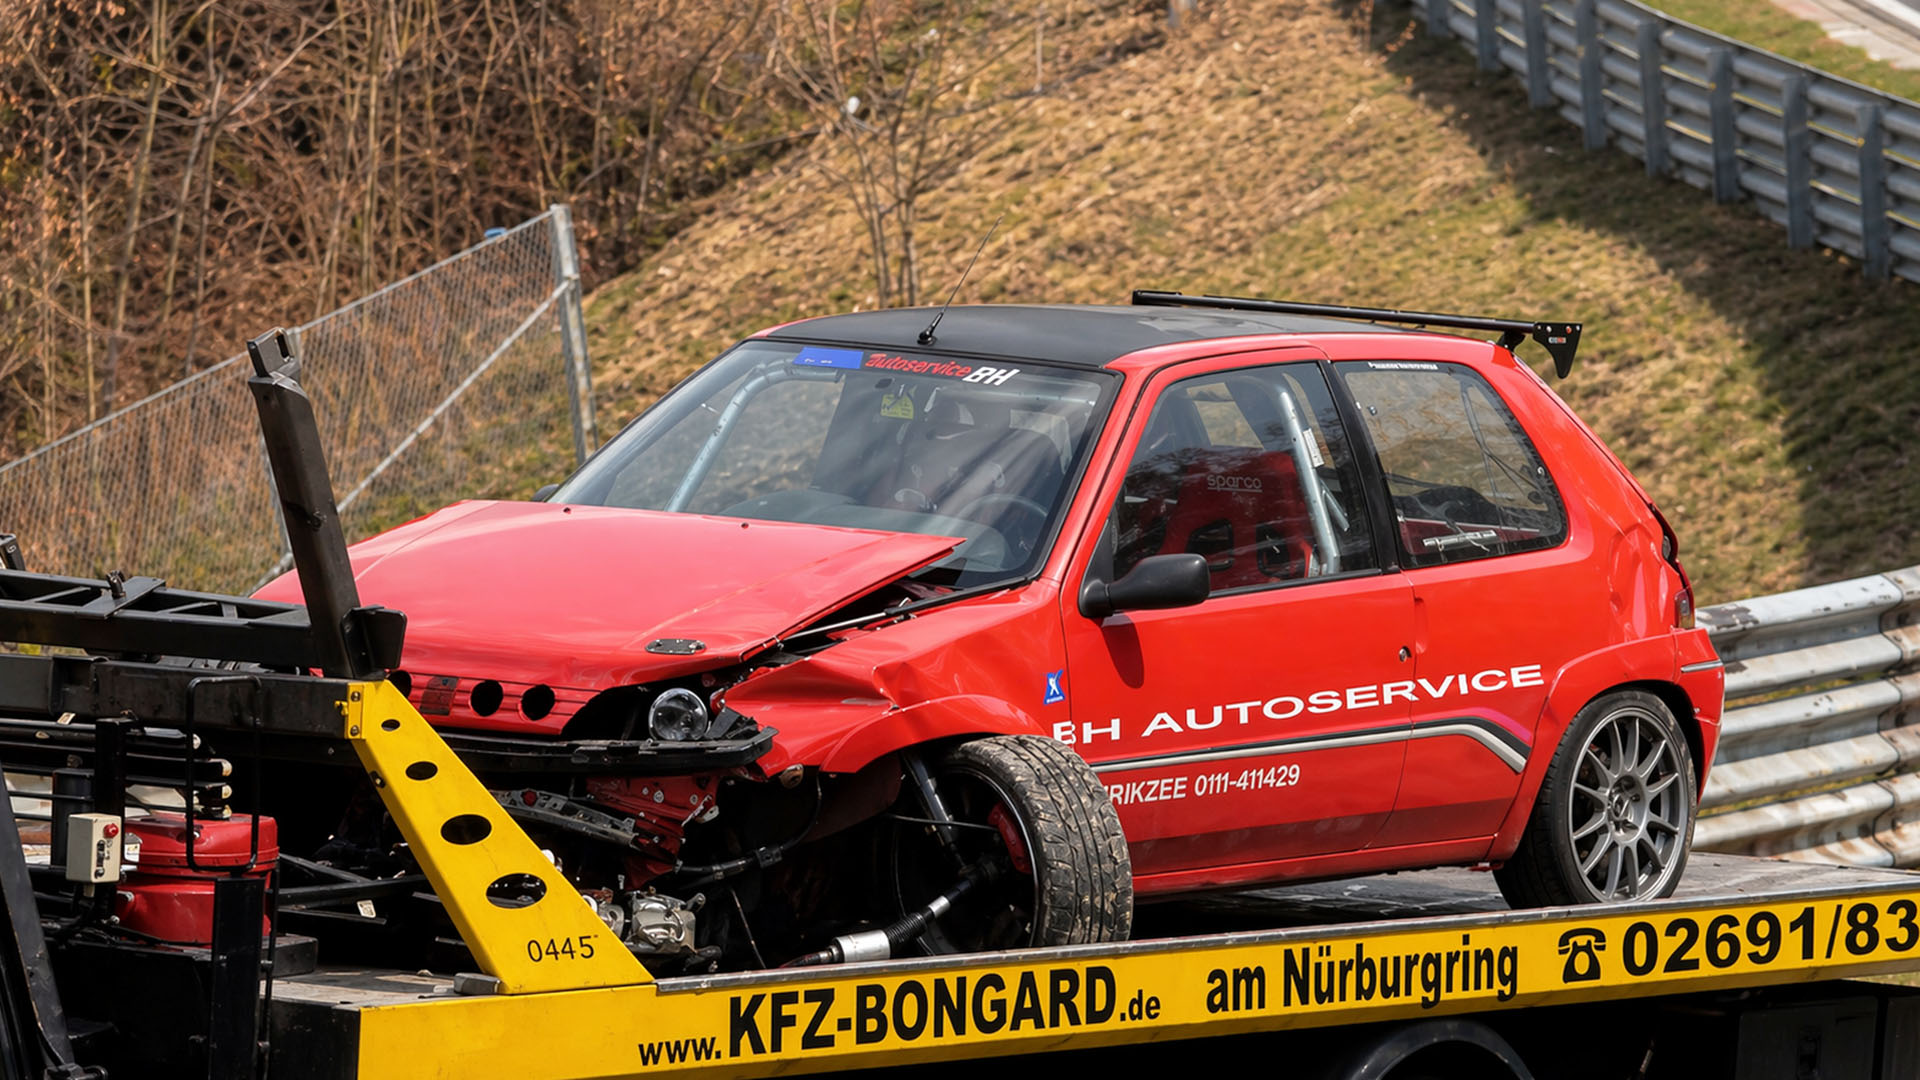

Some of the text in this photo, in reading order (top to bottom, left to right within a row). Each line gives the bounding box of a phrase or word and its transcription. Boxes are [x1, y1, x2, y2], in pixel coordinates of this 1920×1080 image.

[962, 366, 1020, 386] BH
[1207, 474, 1262, 492] sparco
[1053, 664, 1545, 745] BH AUTOSERVICE
[1104, 764, 1301, 805] RIKZEE 0111-411429
[527, 935, 595, 963] 0445
[1206, 968, 1267, 1013] am
[1282, 935, 1519, 1009] Nürburgring
[1621, 899, 1920, 976] 02691/83
